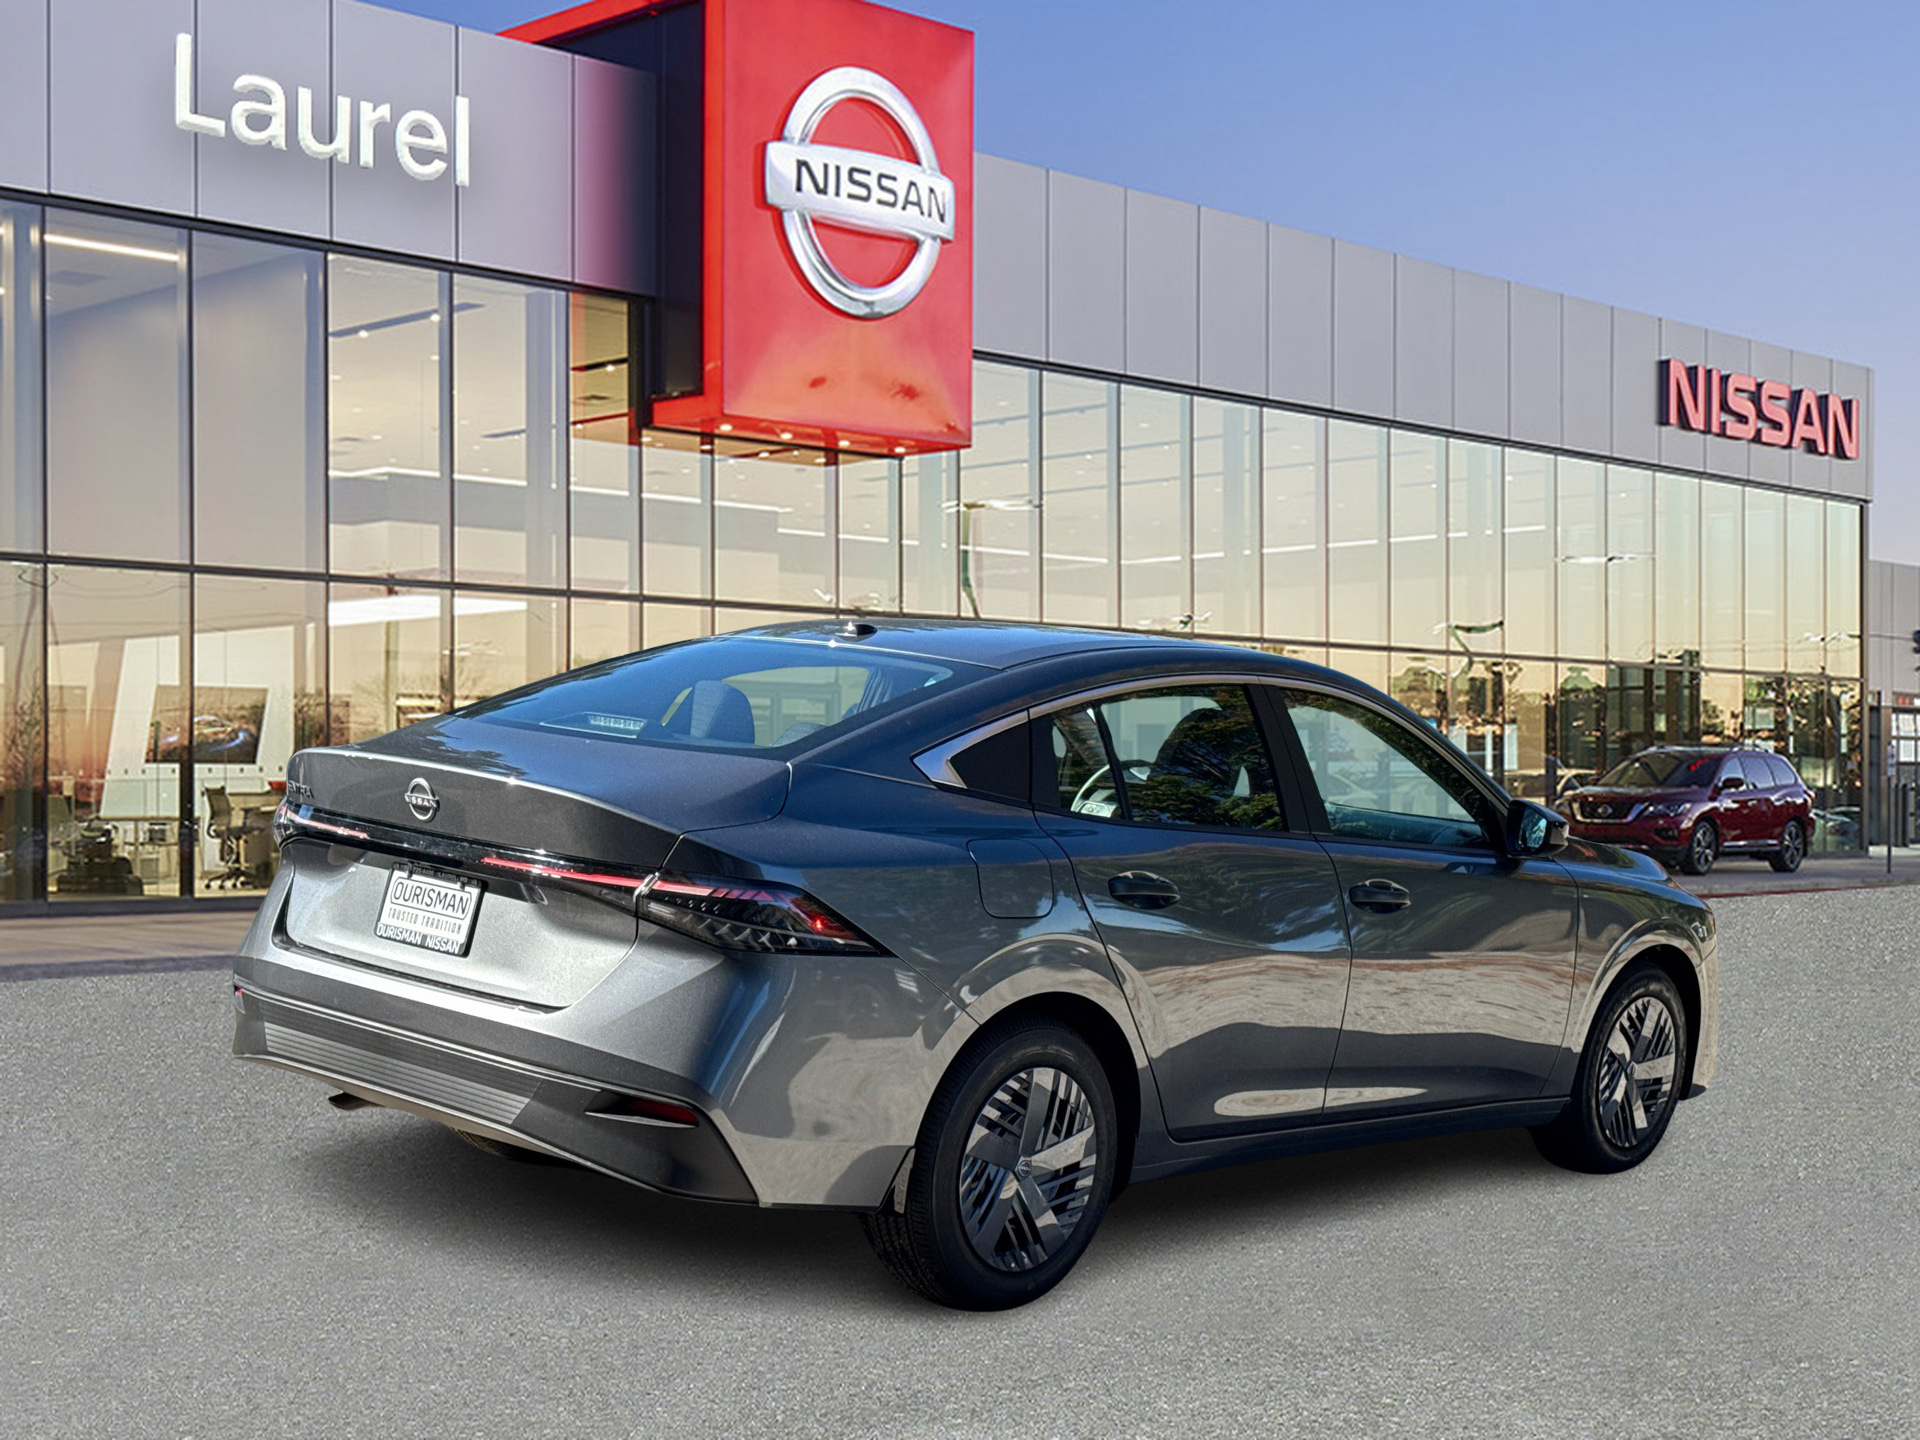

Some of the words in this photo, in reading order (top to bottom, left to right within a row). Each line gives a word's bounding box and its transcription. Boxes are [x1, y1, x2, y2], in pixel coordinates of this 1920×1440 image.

[175, 32, 470, 188] Laurel
[795, 159, 946, 223] NISSAN
[1662, 358, 1859, 459] NISSAN
[404, 793, 437, 808] NISSAN
[393, 881, 469, 915] OURISMAN
[388, 907, 418, 925] TRUSTED
[421, 915, 462, 935] TRADITION
[376, 923, 423, 945] OURISMAN
[425, 934, 460, 954] NISSAN
